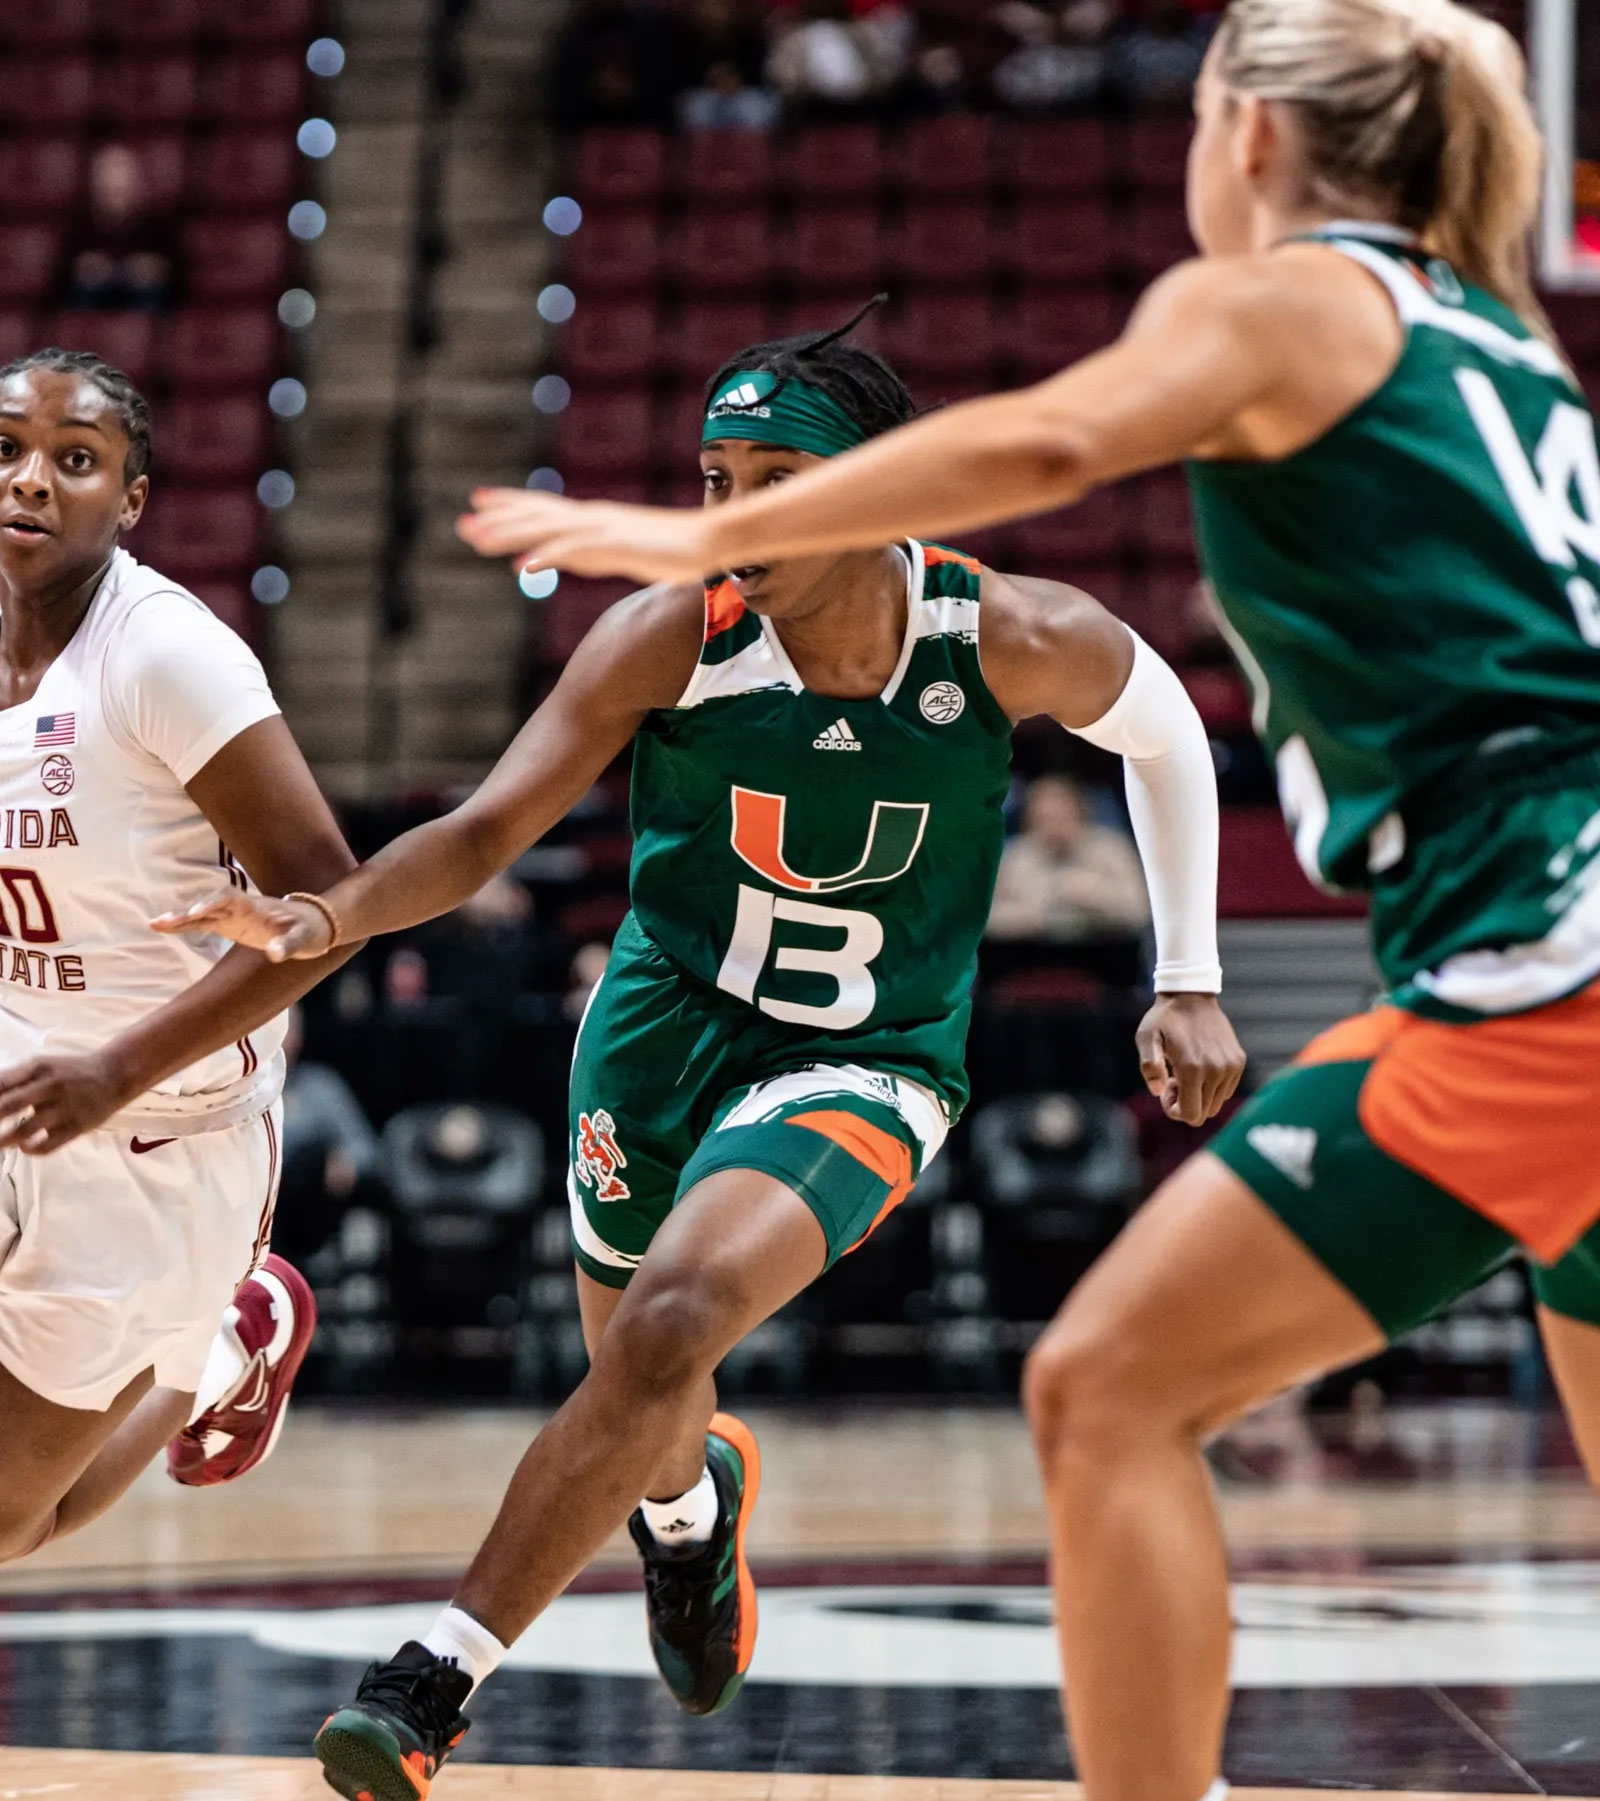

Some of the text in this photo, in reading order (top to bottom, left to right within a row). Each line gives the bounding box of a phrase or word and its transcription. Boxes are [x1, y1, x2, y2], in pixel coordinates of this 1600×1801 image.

[926, 694, 959, 706] ACC
[813, 738, 862, 751] adidas
[45, 767, 73, 777] ACC
[730, 784, 930, 893] U
[716, 882, 884, 1030] 13
[863, 1079, 902, 1110] adidas
